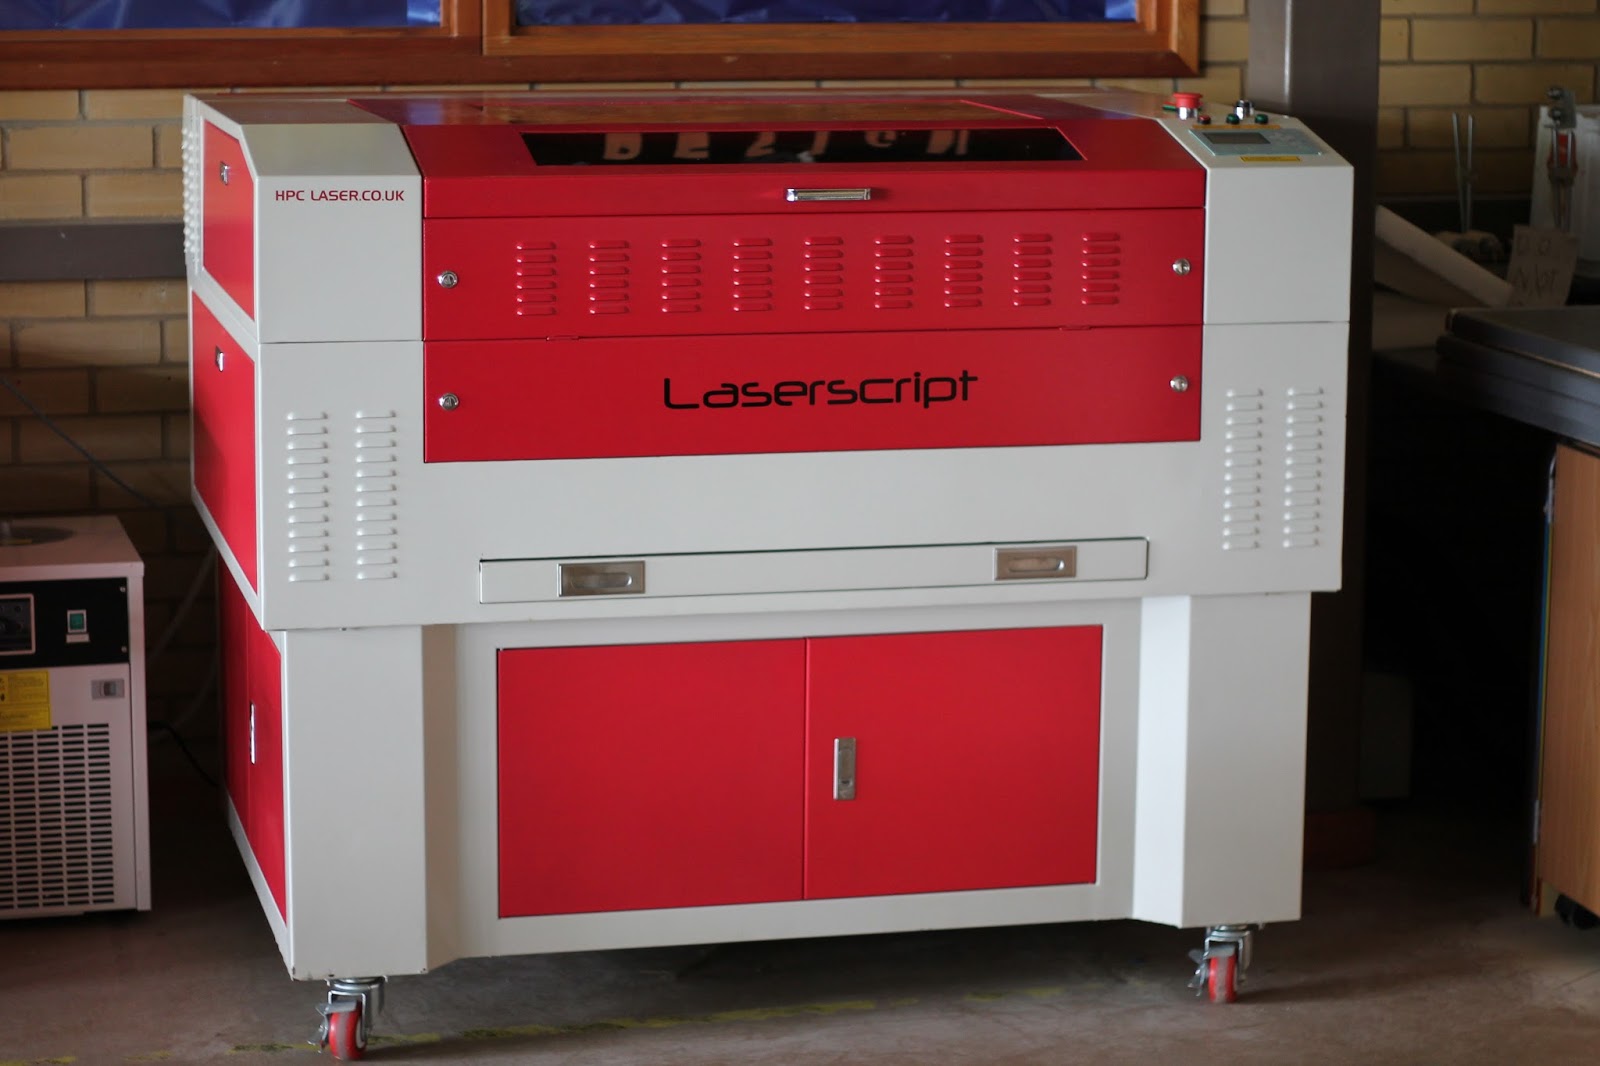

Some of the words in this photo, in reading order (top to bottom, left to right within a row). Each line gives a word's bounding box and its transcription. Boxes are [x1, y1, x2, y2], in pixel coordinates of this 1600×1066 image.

[275, 190, 305, 201] HPC
[310, 190, 405, 201] LASER.CO.UK
[663, 369, 979, 410] Laserscript
